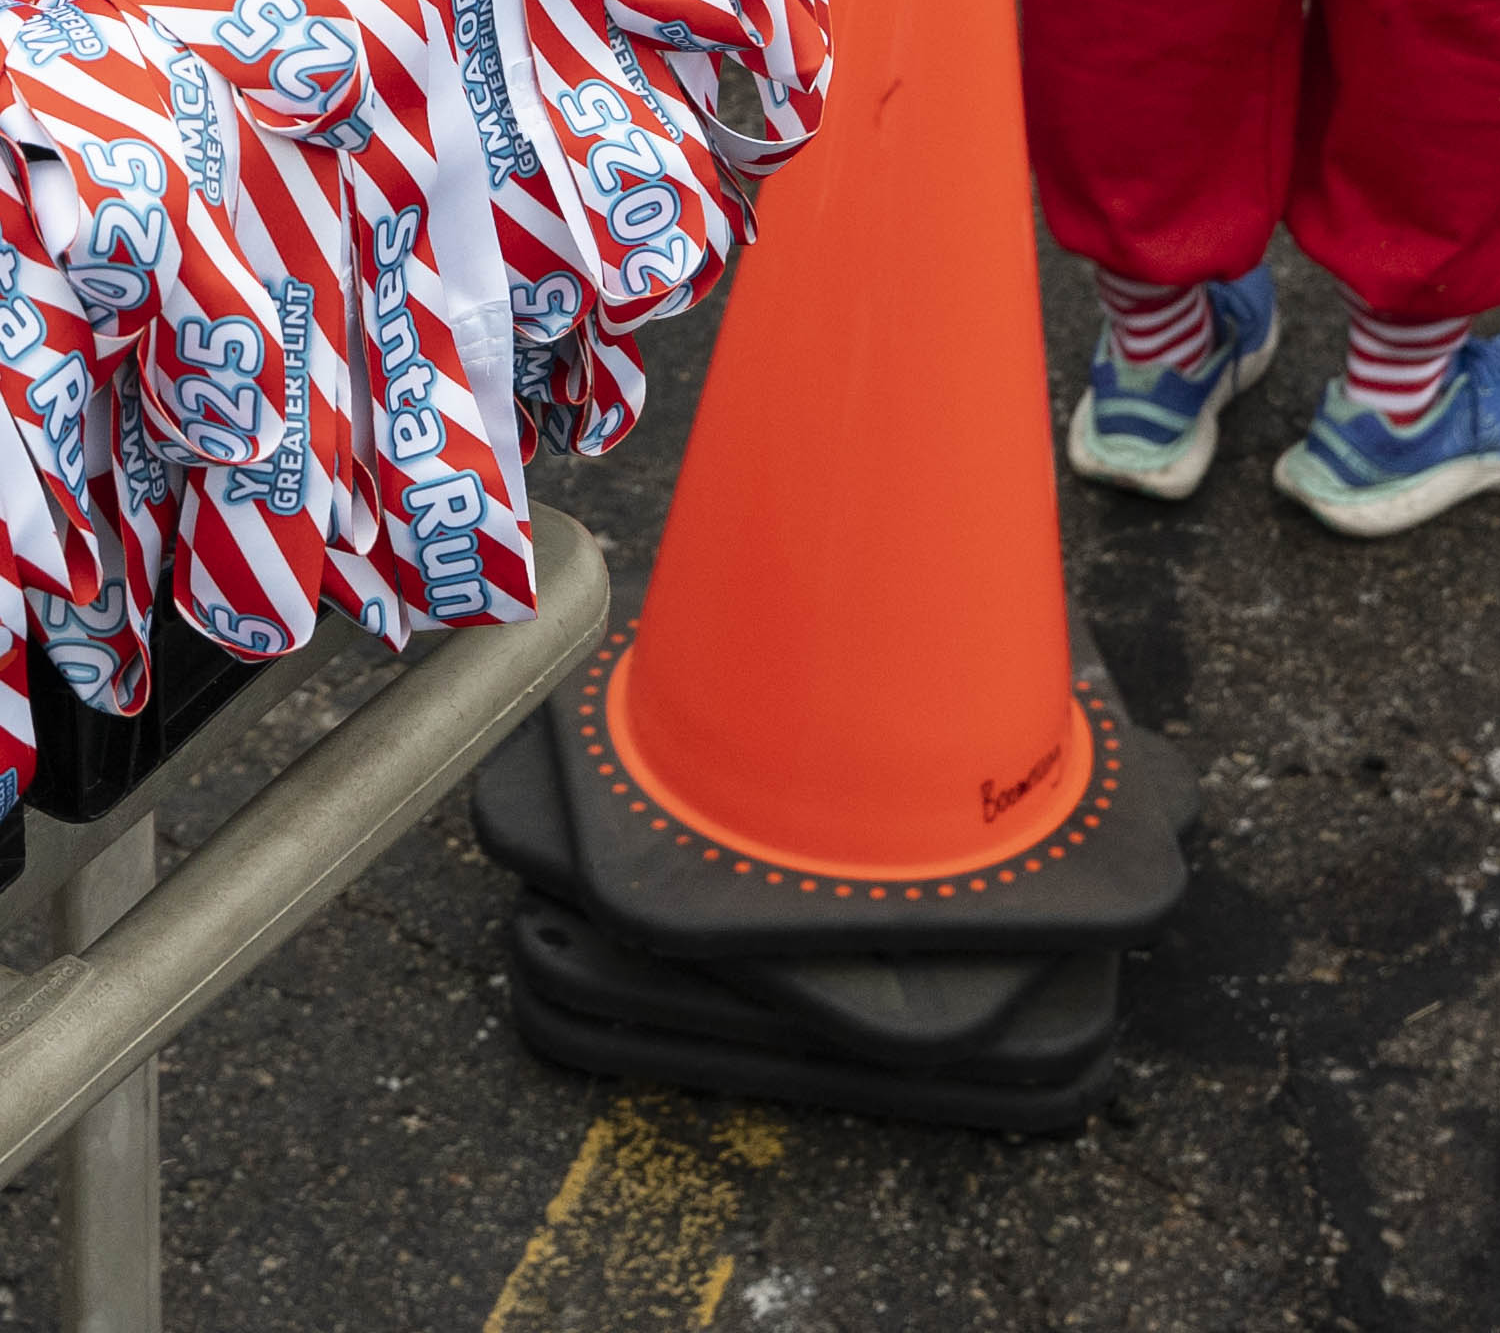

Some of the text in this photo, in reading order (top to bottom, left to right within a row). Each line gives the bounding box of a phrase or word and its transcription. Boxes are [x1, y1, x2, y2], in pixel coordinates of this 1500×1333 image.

[463, 54, 513, 190] YMCA
[562, 82, 686, 297] 2025
[271, 284, 309, 511] GREATER FLINT
[377, 208, 488, 619] Santa Run
